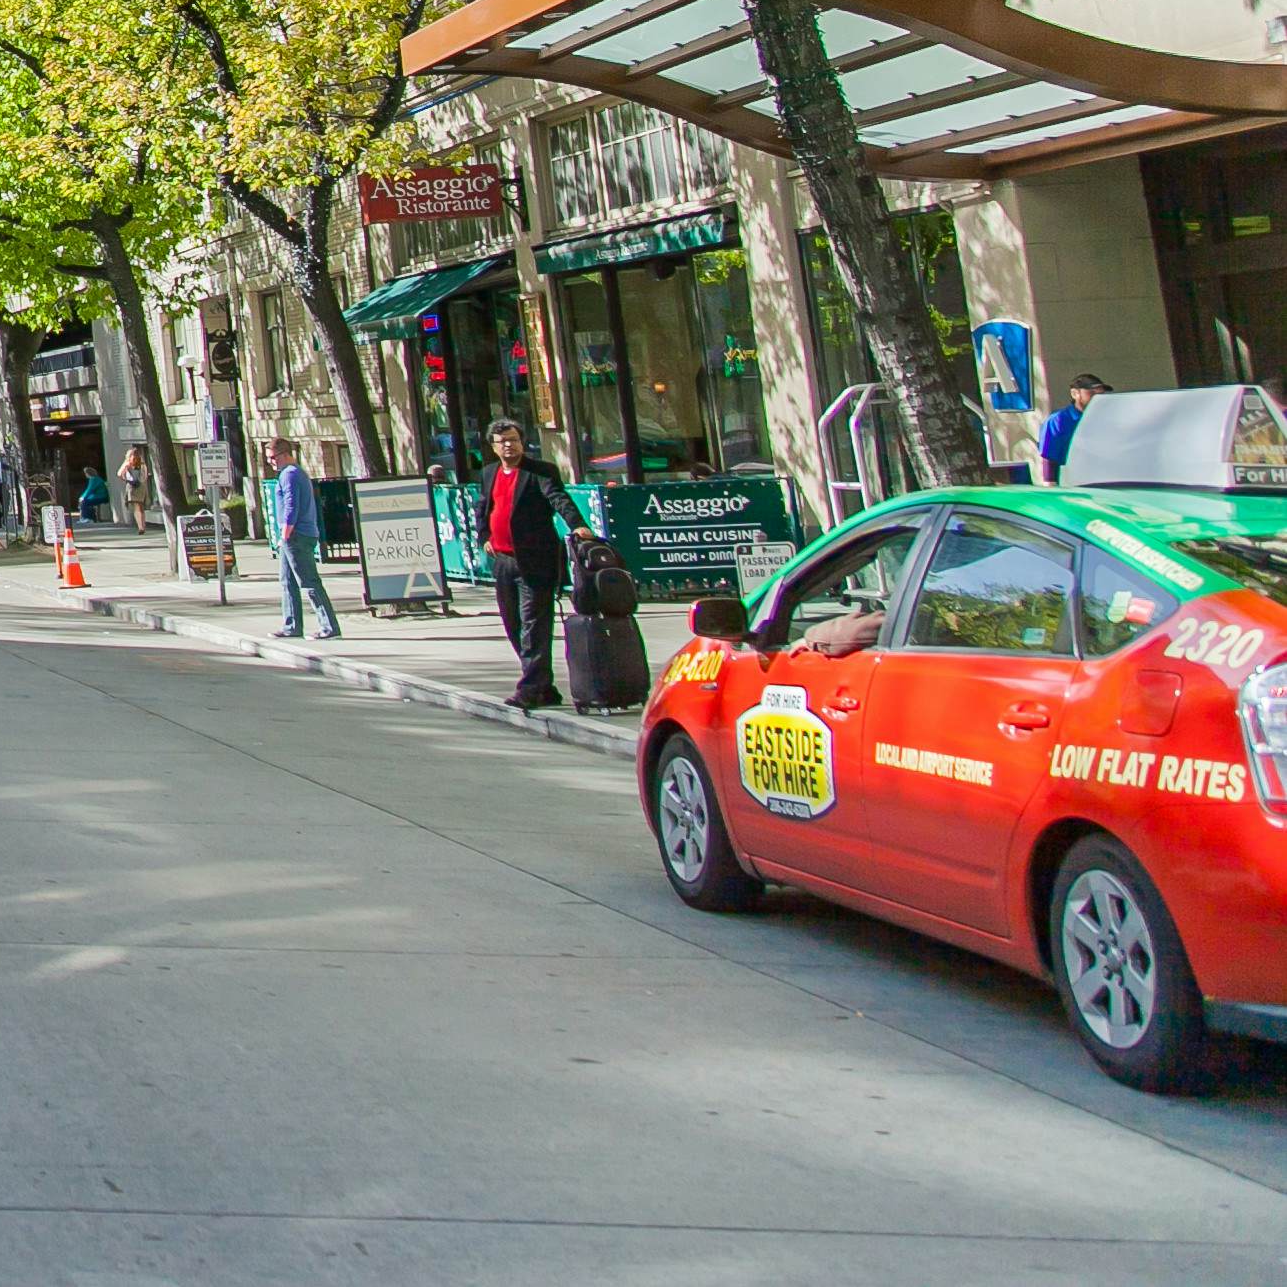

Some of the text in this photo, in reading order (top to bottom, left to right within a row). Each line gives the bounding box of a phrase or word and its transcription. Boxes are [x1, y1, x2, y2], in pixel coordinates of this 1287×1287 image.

[370, 170, 490, 200] Assaggio
[395, 197, 491, 215] Ristorante
[1234, 467, 1268, 483] For
[643, 491, 745, 517] Assaggio
[375, 527, 420, 542] VALET
[639, 531, 700, 544] ITALIAN
[367, 543, 435, 561] PARKING
[660, 550, 736, 563] LUNCH DINN
[744, 568, 766, 578] LOAD
[1164, 617, 1264, 669] 2320
[766, 692, 802, 710] FOR HIRE
[745, 723, 823, 764] EASTSIDE
[875, 742, 993, 787] LOCAL AND AIRPORT SERVICE
[1049, 744, 1247, 803] LOW FLAT RATES
[752, 757, 820, 800] FOR HIRE
